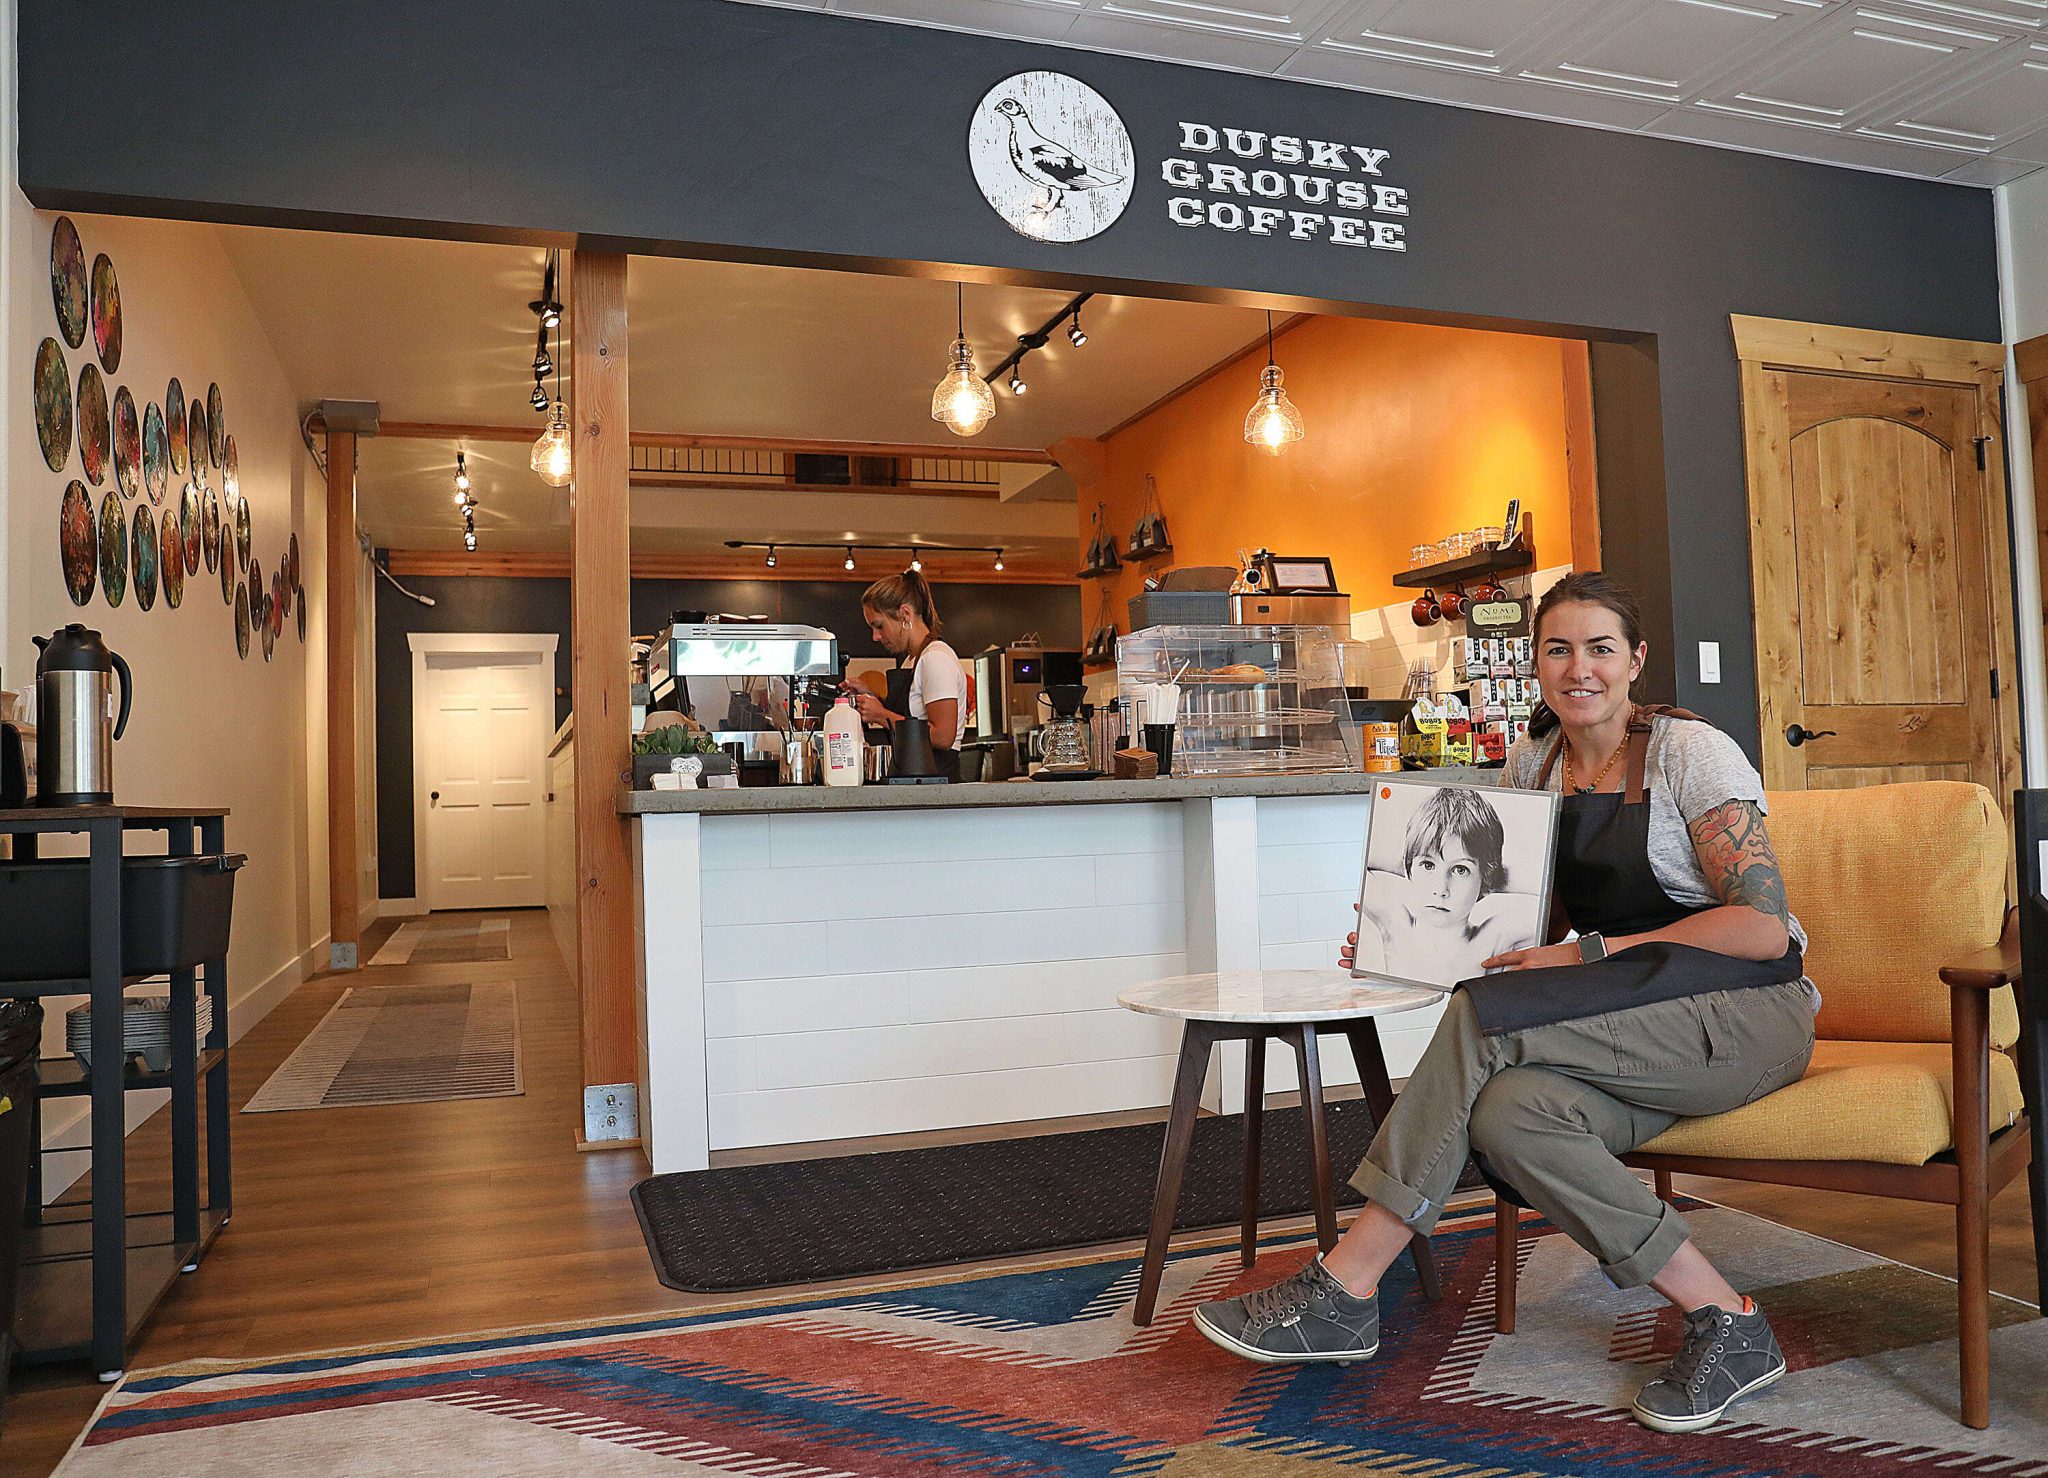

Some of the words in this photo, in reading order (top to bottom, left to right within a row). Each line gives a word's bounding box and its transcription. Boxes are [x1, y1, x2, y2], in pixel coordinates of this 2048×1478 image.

[1178, 121, 1391, 177] DUSKY
[1161, 157, 1409, 217] GROUSE
[1167, 196, 1407, 252] COFFEE
